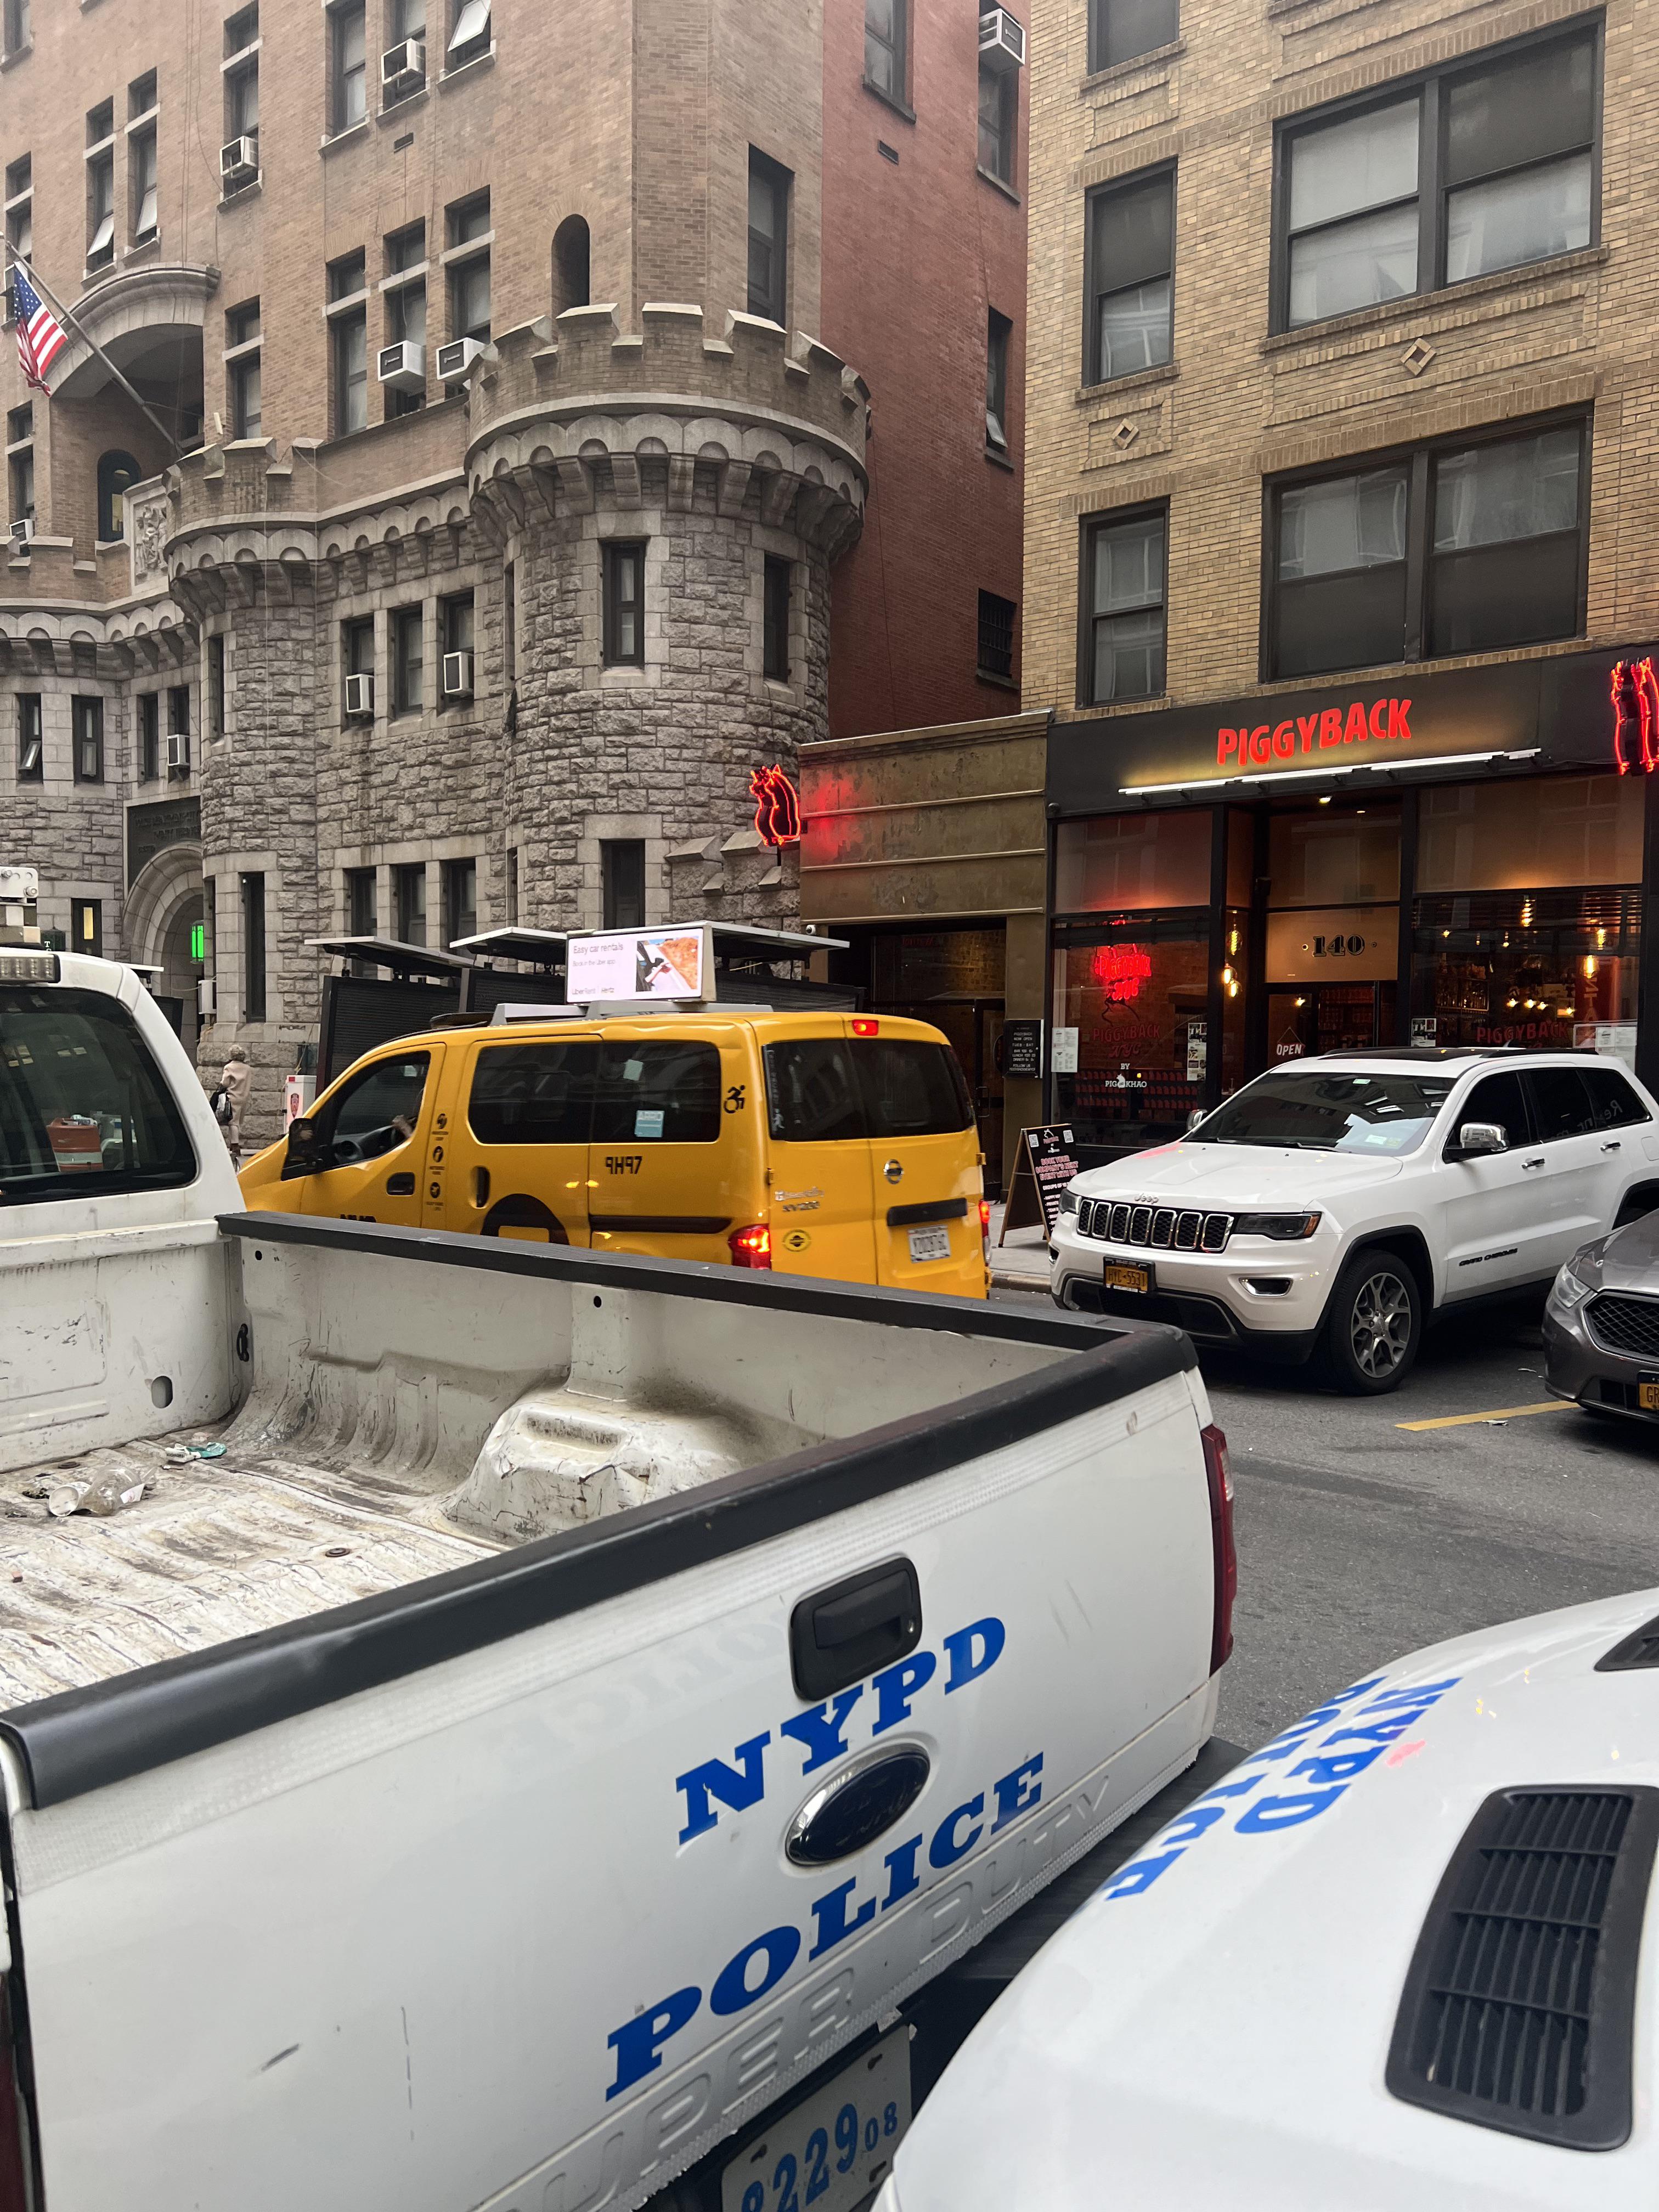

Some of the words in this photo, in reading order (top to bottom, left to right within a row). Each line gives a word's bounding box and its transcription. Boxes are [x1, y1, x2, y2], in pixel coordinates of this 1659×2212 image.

[1217, 699, 1412, 766] PIGGYBACK
[573, 945, 588, 955] Easy
[601, 943, 624, 952] rentals
[1312, 934, 1365, 957] 140
[1093, 1024, 1160, 1042] PIGGYBACK
[1476, 1020, 1568, 1043] PIGGYBACK
[1276, 1043, 1302, 1056] OPEN
[605, 1155, 642, 1174] 9H97
[1134, 1193, 1159, 1204] Jeep
[676, 1617, 1005, 1844] NYPD
[1235, 1677, 1463, 1833] NYPD
[606, 1752, 1043, 2101] POLICE
[502, 1967, 854, 2212] UPER
[919, 1774, 1110, 1965] DUTY
[865, 2101, 898, 2152] 08
